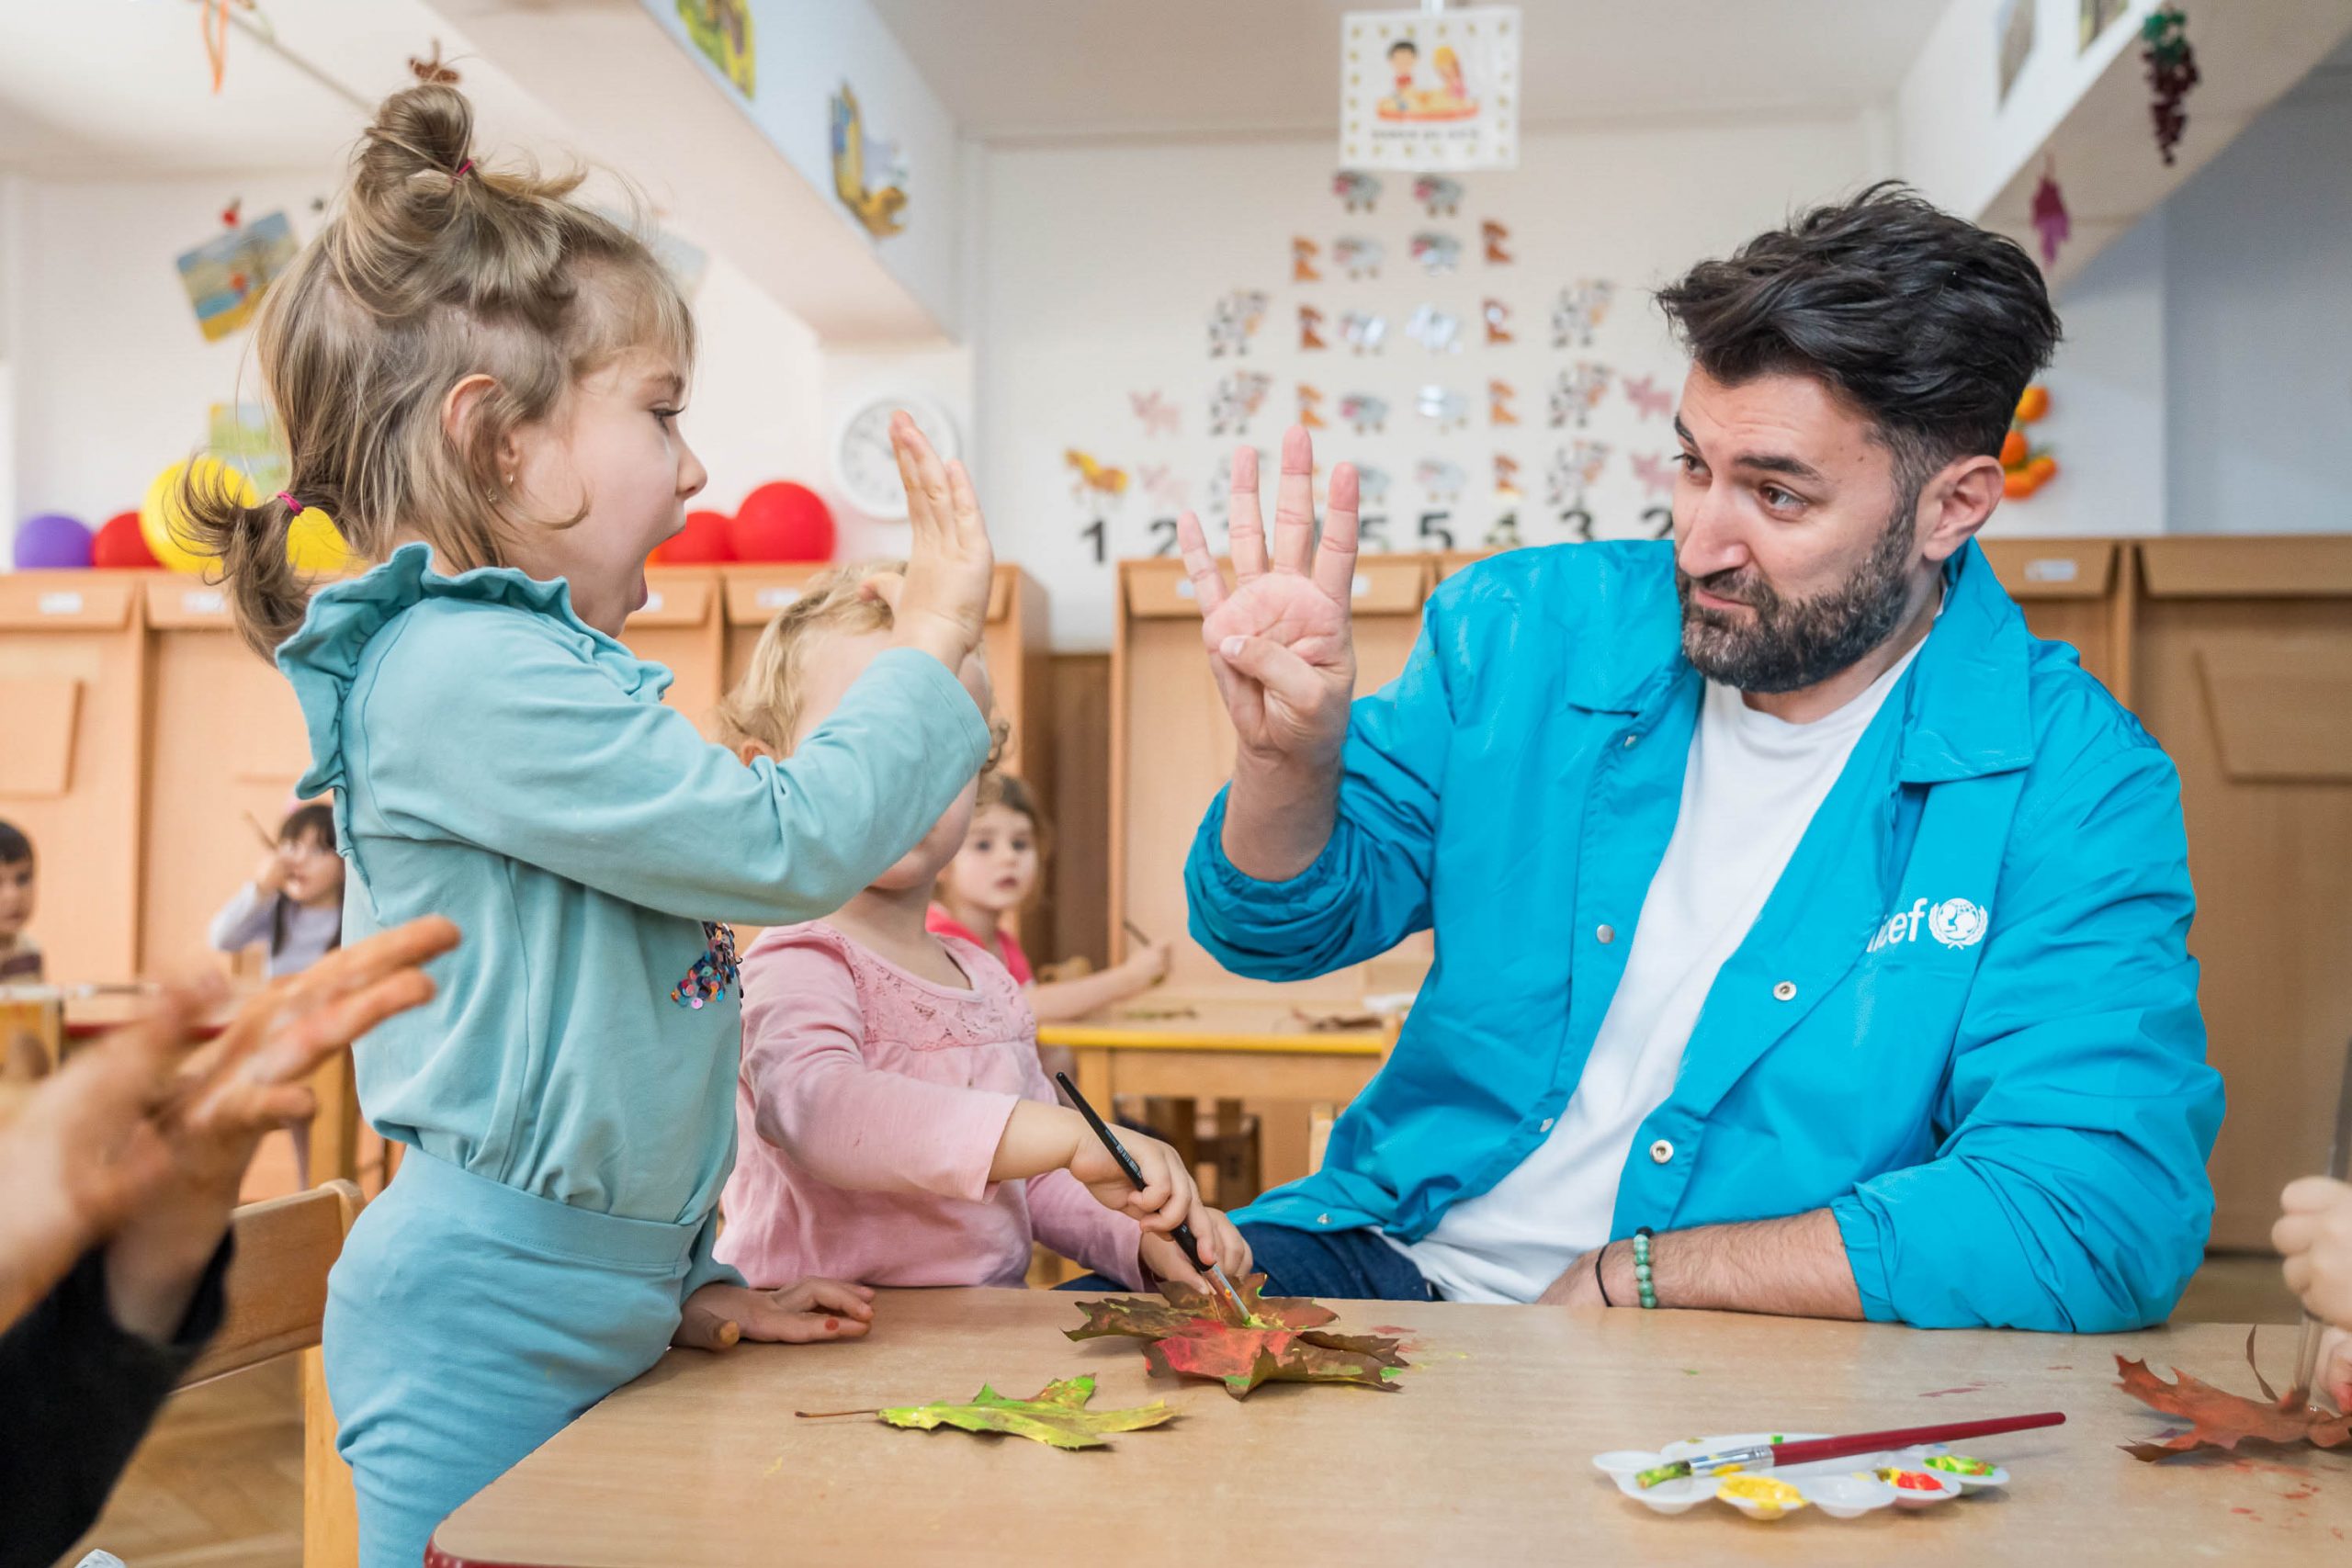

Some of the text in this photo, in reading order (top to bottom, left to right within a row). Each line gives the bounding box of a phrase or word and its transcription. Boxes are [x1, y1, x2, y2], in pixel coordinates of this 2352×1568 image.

[1082, 520, 1106, 563] 1
[1150, 519, 1180, 556] 2
[1420, 512, 1453, 550] 5
